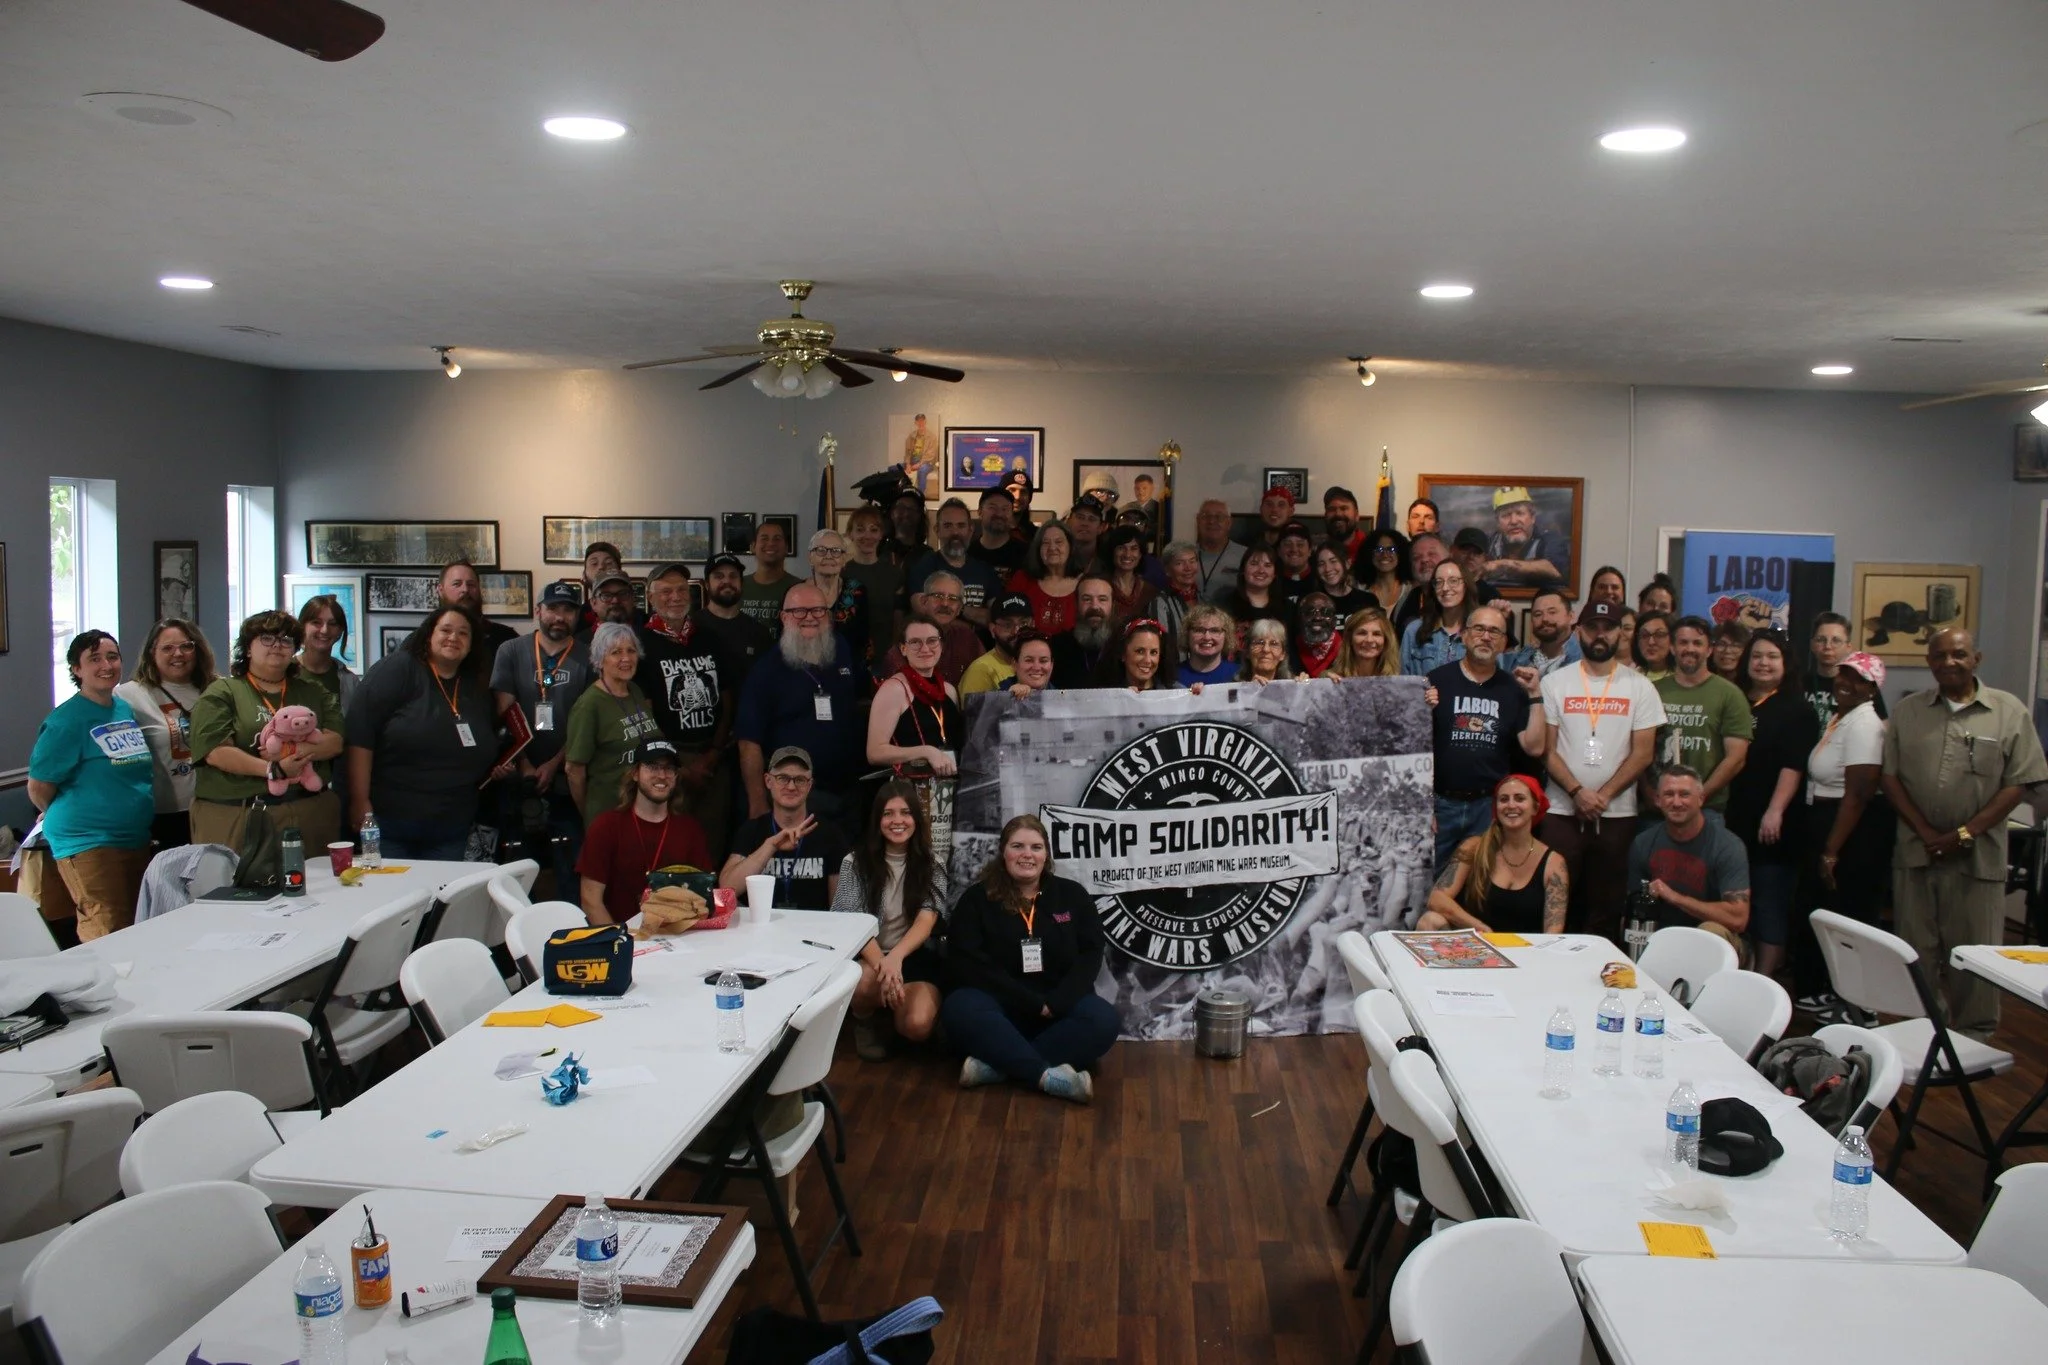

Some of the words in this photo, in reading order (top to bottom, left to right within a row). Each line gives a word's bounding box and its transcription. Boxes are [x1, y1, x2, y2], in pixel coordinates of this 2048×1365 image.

[660, 659, 694, 677] BLACK
[692, 655, 716, 671] LUNG
[679, 708, 715, 730] KILLS
[1454, 696, 1499, 719] LABOR
[1451, 731, 1498, 744] HERITAGE
[1097, 737, 1163, 800] WEST
[1176, 728, 1282, 791] VIRGINIA
[1159, 767, 1204, 790] MINGO
[1052, 822, 1137, 859] CAMP
[1150, 806, 1329, 855] SOLIDARITY!
[761, 857, 824, 879] ATEWAN
[1093, 870, 1099, 881] A
[1101, 868, 1134, 881] PROJECT
[1137, 867, 1146, 880] OF
[1149, 866, 1162, 879] THE
[1165, 863, 1182, 877] WEST
[1184, 860, 1214, 875] VIRGINIA
[1217, 859, 1235, 872] MINE
[1238, 857, 1257, 870] WARS
[1260, 855, 1291, 869] MUSEUM
[1094, 895, 1142, 948] MINE
[1147, 934, 1211, 964] WARS
[1223, 878, 1300, 955] MUSEUM
[1136, 904, 1185, 933] PRESERVE
[1193, 922, 1200, 933] &
[1206, 894, 1252, 930] EDUCATE
[556, 962, 610, 981] USW
